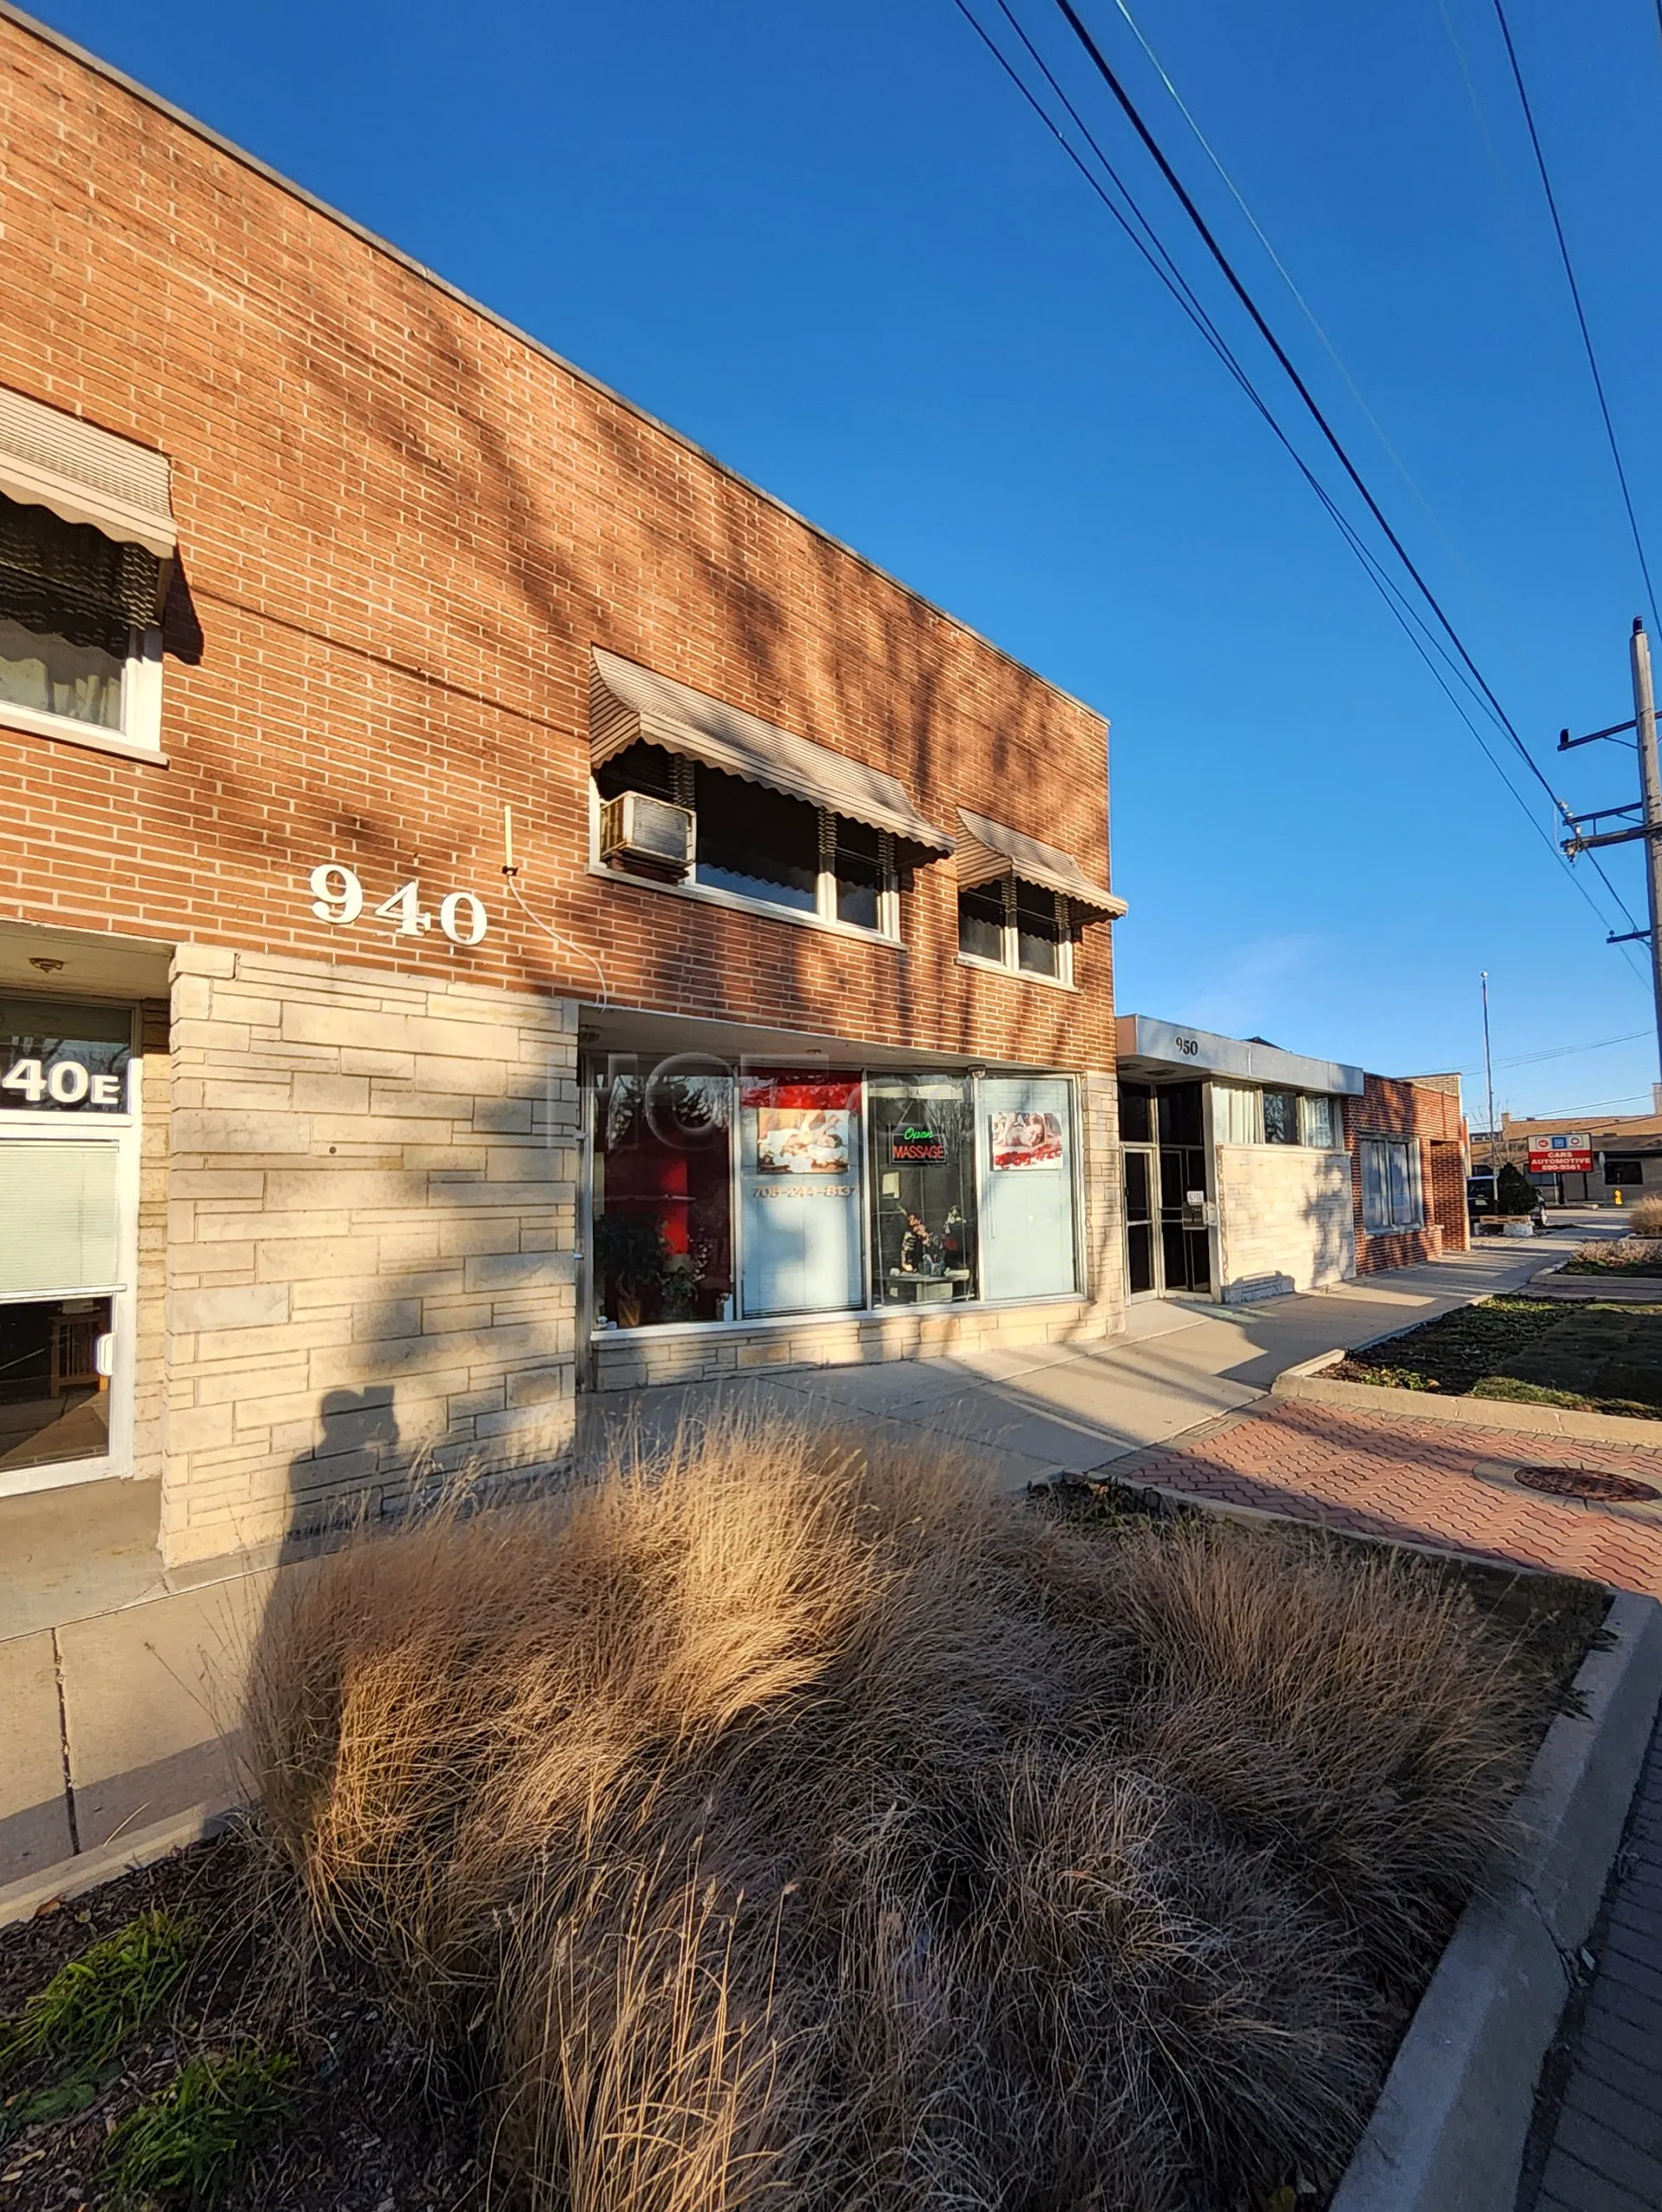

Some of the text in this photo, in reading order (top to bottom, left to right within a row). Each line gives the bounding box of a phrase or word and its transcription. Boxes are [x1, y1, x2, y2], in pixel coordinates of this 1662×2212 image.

[309, 864, 487, 945] 940
[1175, 1037, 1199, 1056] 950
[904, 1127, 933, 1143] Open
[893, 1145, 945, 1159] MASSAGE
